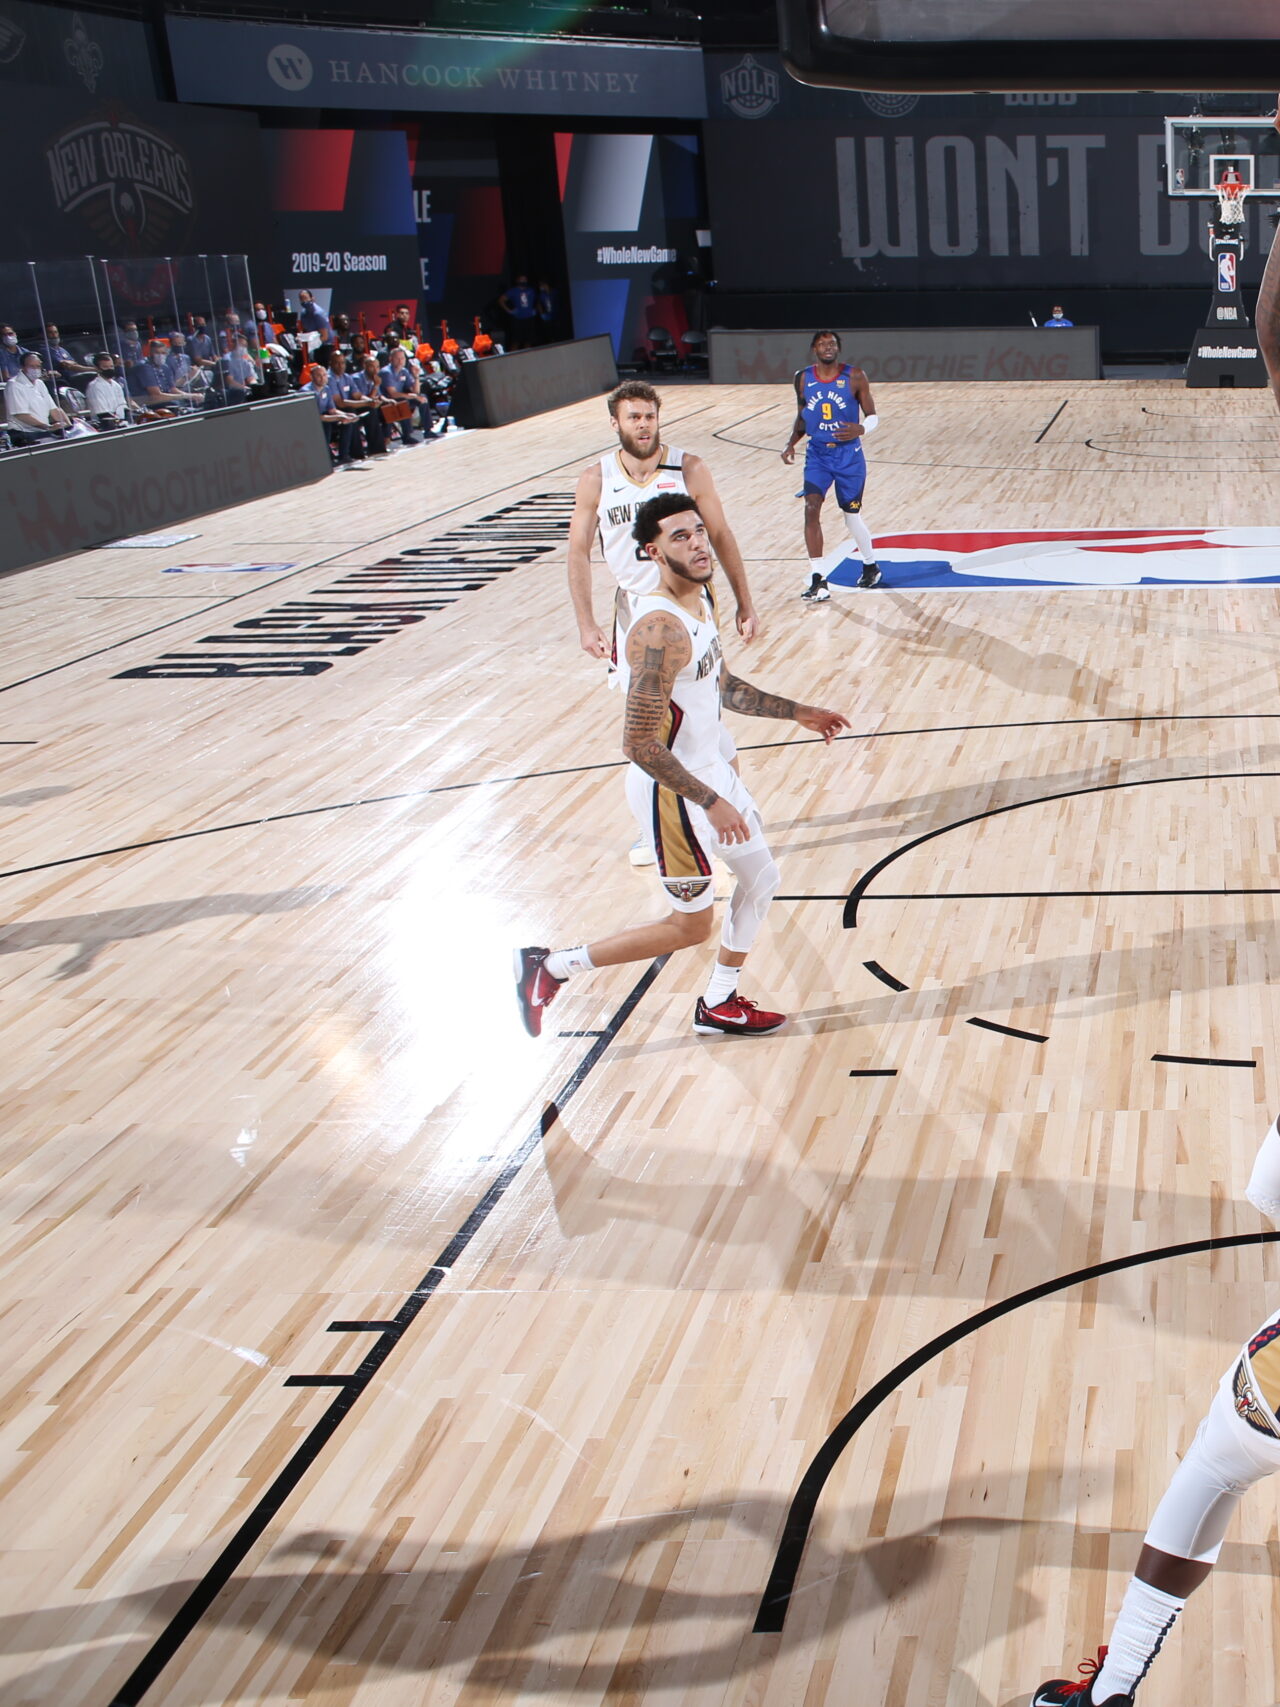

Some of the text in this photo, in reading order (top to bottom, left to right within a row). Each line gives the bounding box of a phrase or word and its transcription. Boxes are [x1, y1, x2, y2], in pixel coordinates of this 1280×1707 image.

[328, 60, 640, 94] HANCOCK WHITNEY
[723, 70, 778, 100] NOLA
[47, 131, 193, 209] NEW ORLEANS
[834, 134, 1106, 259] WON'T
[291, 252, 387, 273] 2019-20 Season
[596, 246, 677, 265] #WholeNewGame
[1216, 306, 1238, 321] @NBA
[1197, 346, 1258, 359] #WholeNewGame
[807, 351, 978, 380] OOTHIE
[806, 390, 847, 412] MILE HIGH
[821, 402, 833, 421] 9
[818, 420, 840, 432] CITY
[88, 459, 246, 534] SMOOTHIE
[606, 503, 632, 527] NEW
[308, 545, 557, 594] LIVES
